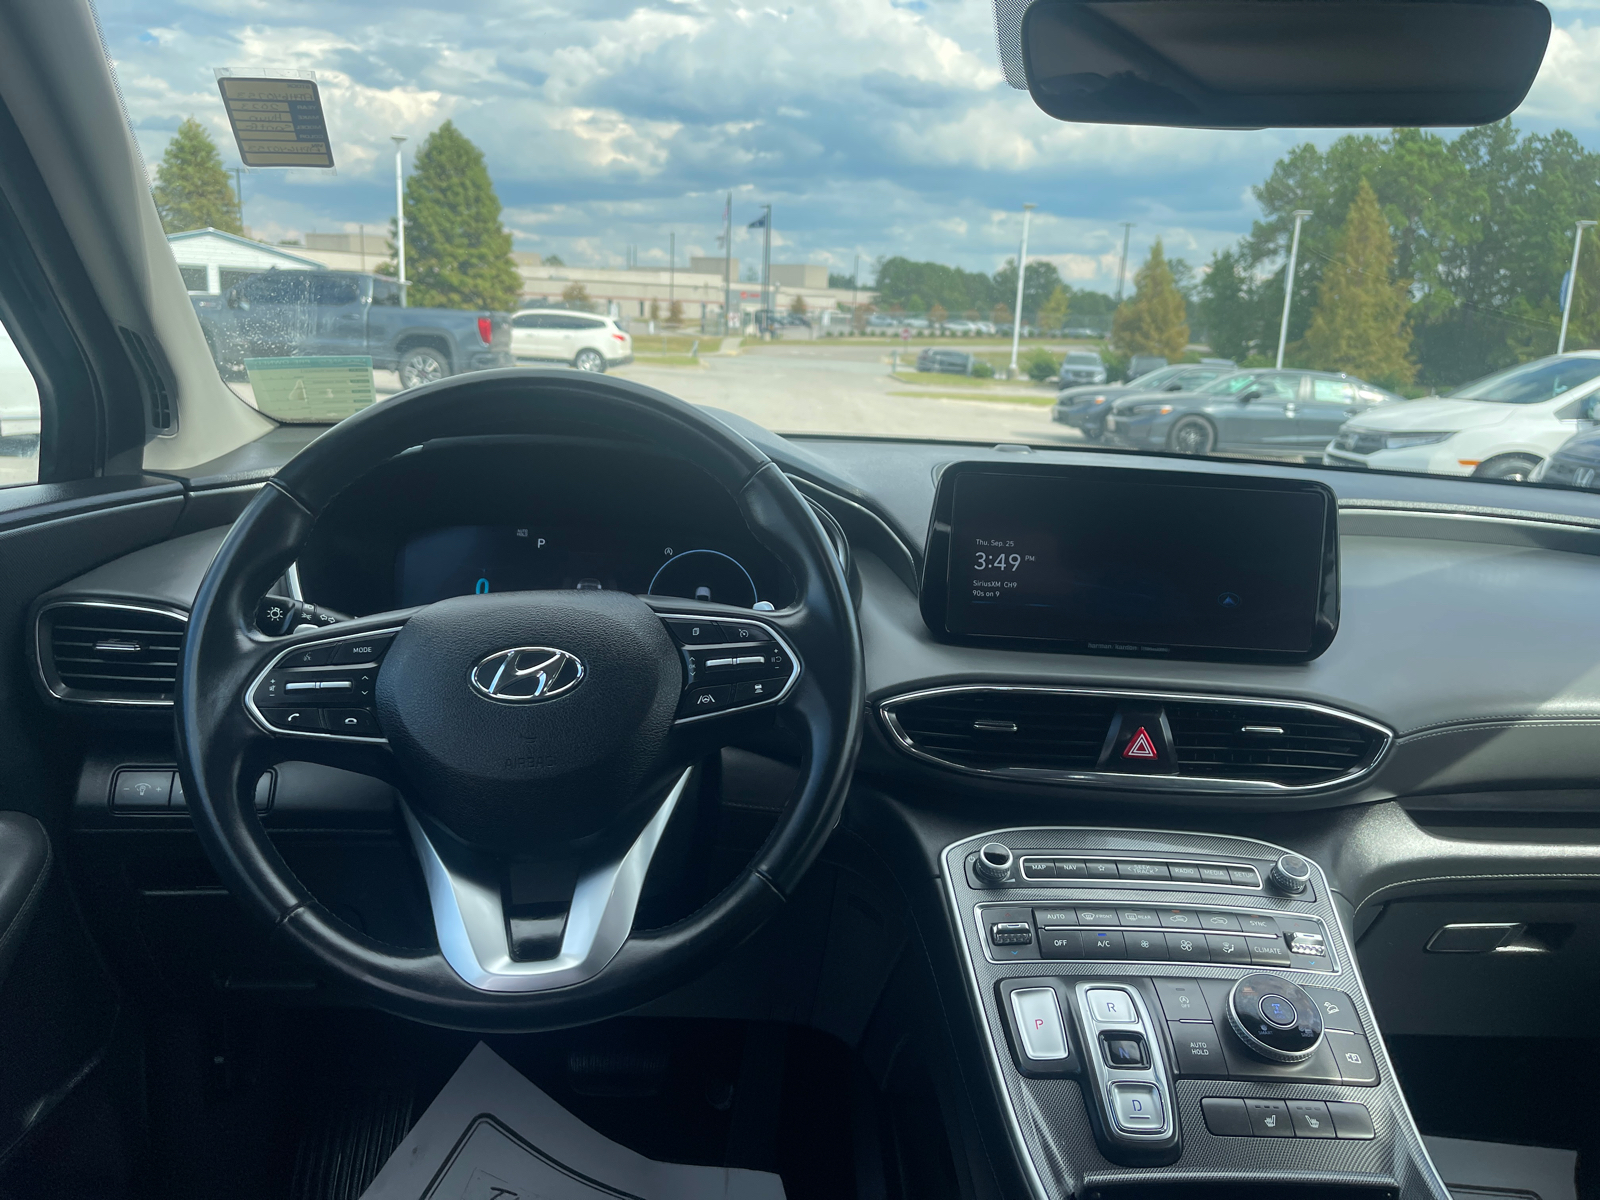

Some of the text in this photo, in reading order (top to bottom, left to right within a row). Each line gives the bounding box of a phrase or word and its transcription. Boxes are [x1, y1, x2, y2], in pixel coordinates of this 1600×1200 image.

[538, 539, 545, 548] P
[974, 552, 1021, 571] 3:49
[1106, 1002, 1116, 1012] R
[1035, 1019, 1044, 1030] P
[1118, 1047, 1130, 1059] N
[1132, 1100, 1142, 1111] D
